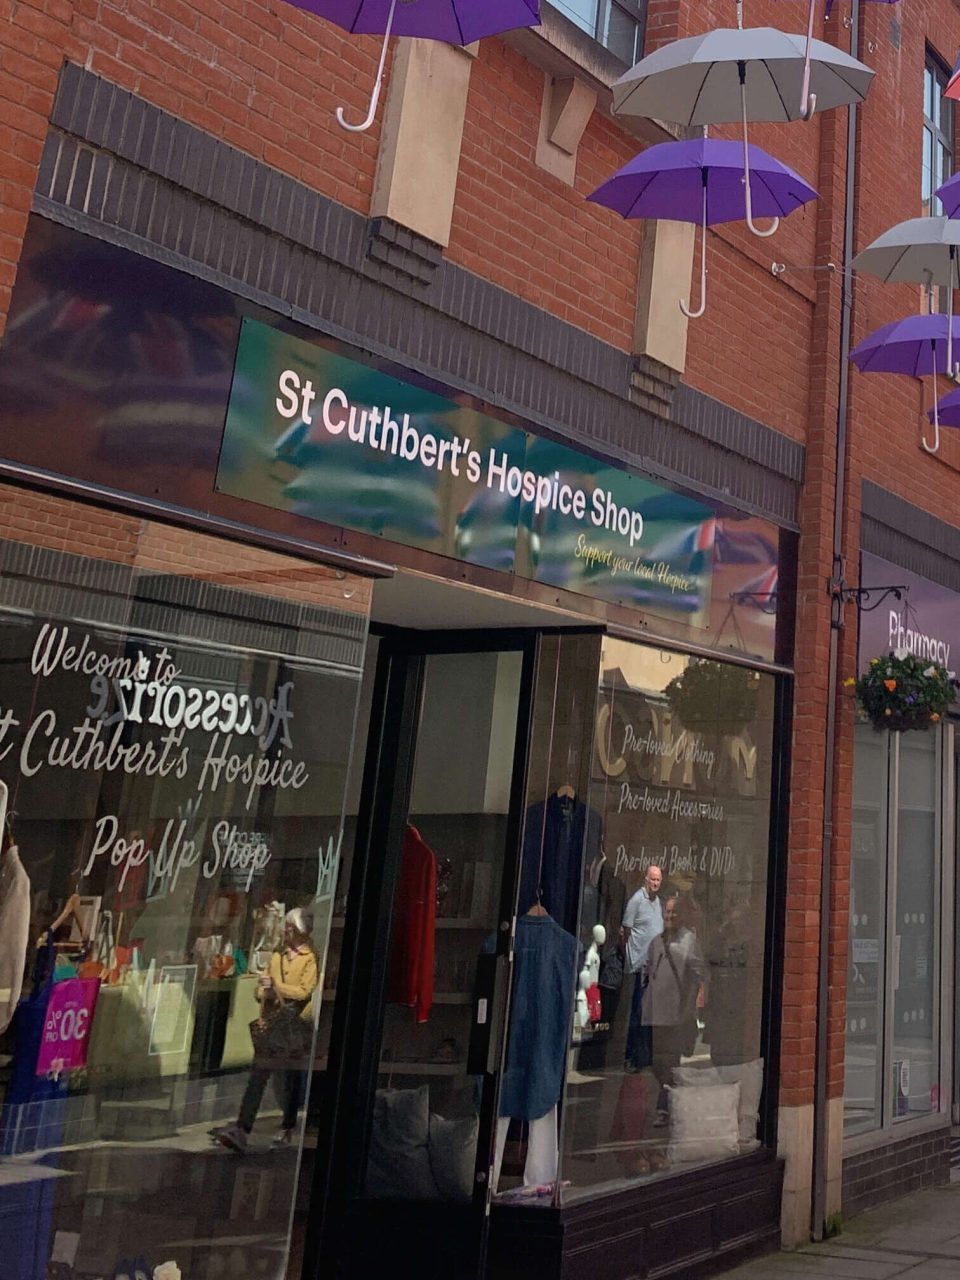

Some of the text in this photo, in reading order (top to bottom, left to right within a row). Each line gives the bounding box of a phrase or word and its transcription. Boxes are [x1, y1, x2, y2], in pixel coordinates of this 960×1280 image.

[275, 369, 644, 547] St Cuthbert's Hospice Shop
[574, 533, 690, 595] Support your local Hospice
[31, 622, 182, 686] Welcome to
[888, 610, 951, 669] Pharmacy
[0, 704, 310, 811] t Cuthbert's Hospice
[674, 728, 716, 780] Clothing
[617, 781, 724, 822] Pre-loved Accessories
[83, 814, 150, 893] Pop
[153, 818, 200, 894] Up
[202, 819, 272, 893] Shop
[668, 844, 699, 876] Books
